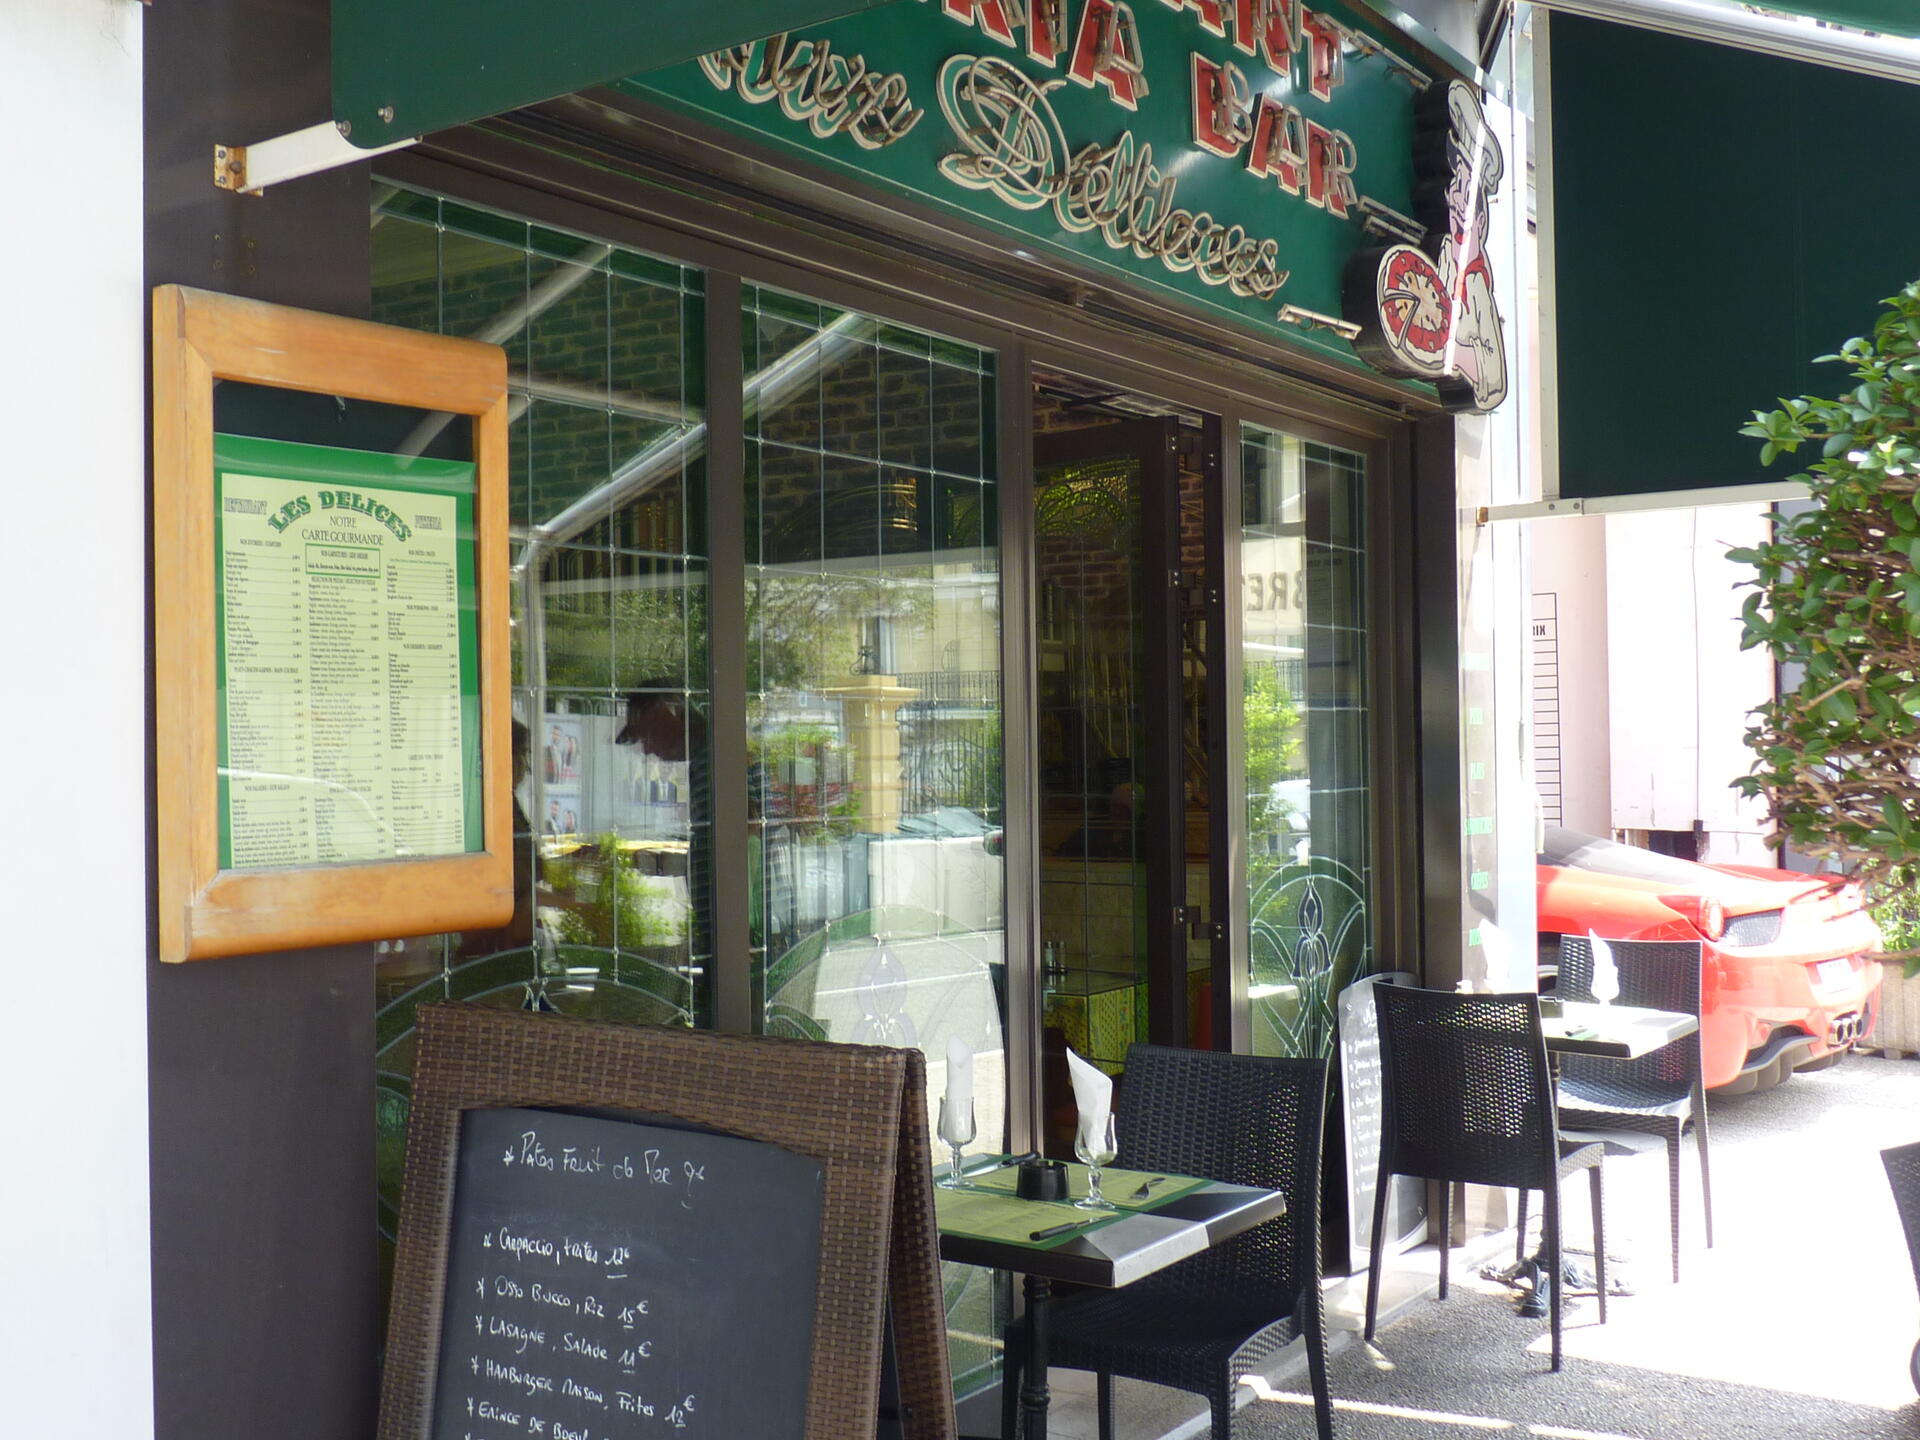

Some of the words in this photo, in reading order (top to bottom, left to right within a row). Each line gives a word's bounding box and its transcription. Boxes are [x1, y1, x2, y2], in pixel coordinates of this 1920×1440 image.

[1191, 51, 1357, 220] BAR
[267, 495, 312, 534] LES
[318, 490, 412, 542] DELICES
[329, 515, 357, 528] NOTRE
[301, 529, 329, 541] CARTE
[329, 531, 384, 546] GOURMANDE
